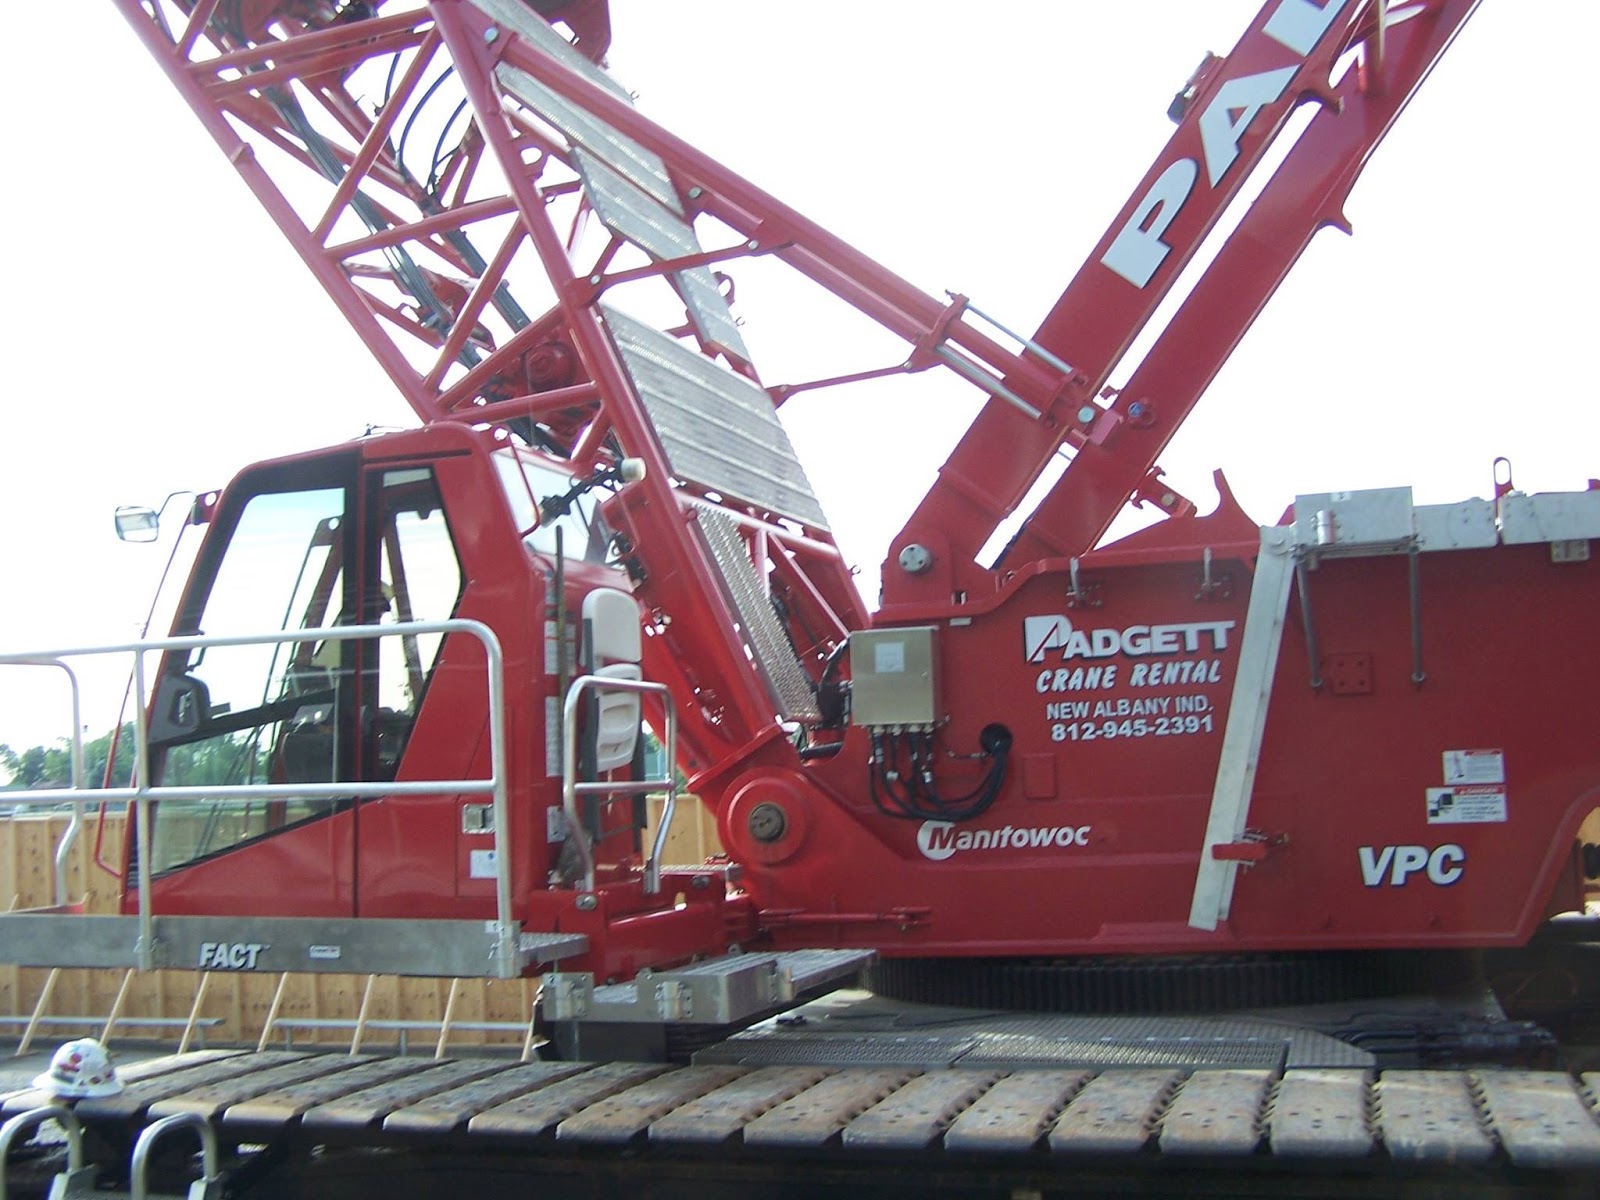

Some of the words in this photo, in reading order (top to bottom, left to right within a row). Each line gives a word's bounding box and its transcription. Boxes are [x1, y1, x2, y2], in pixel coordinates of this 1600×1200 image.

[1024, 614, 1236, 662] PADGETT
[1036, 664, 1118, 693] CRANE
[1129, 659, 1221, 687] RENTAL
[1046, 702, 1090, 720] NEW
[1093, 697, 1171, 717] ALBANY
[1176, 694, 1214, 714] IND.
[1051, 714, 1213, 742] 812-945-2391
[917, 819, 1092, 861] Manitowoc
[1358, 844, 1465, 887] VPC
[199, 942, 262, 969] FACT
